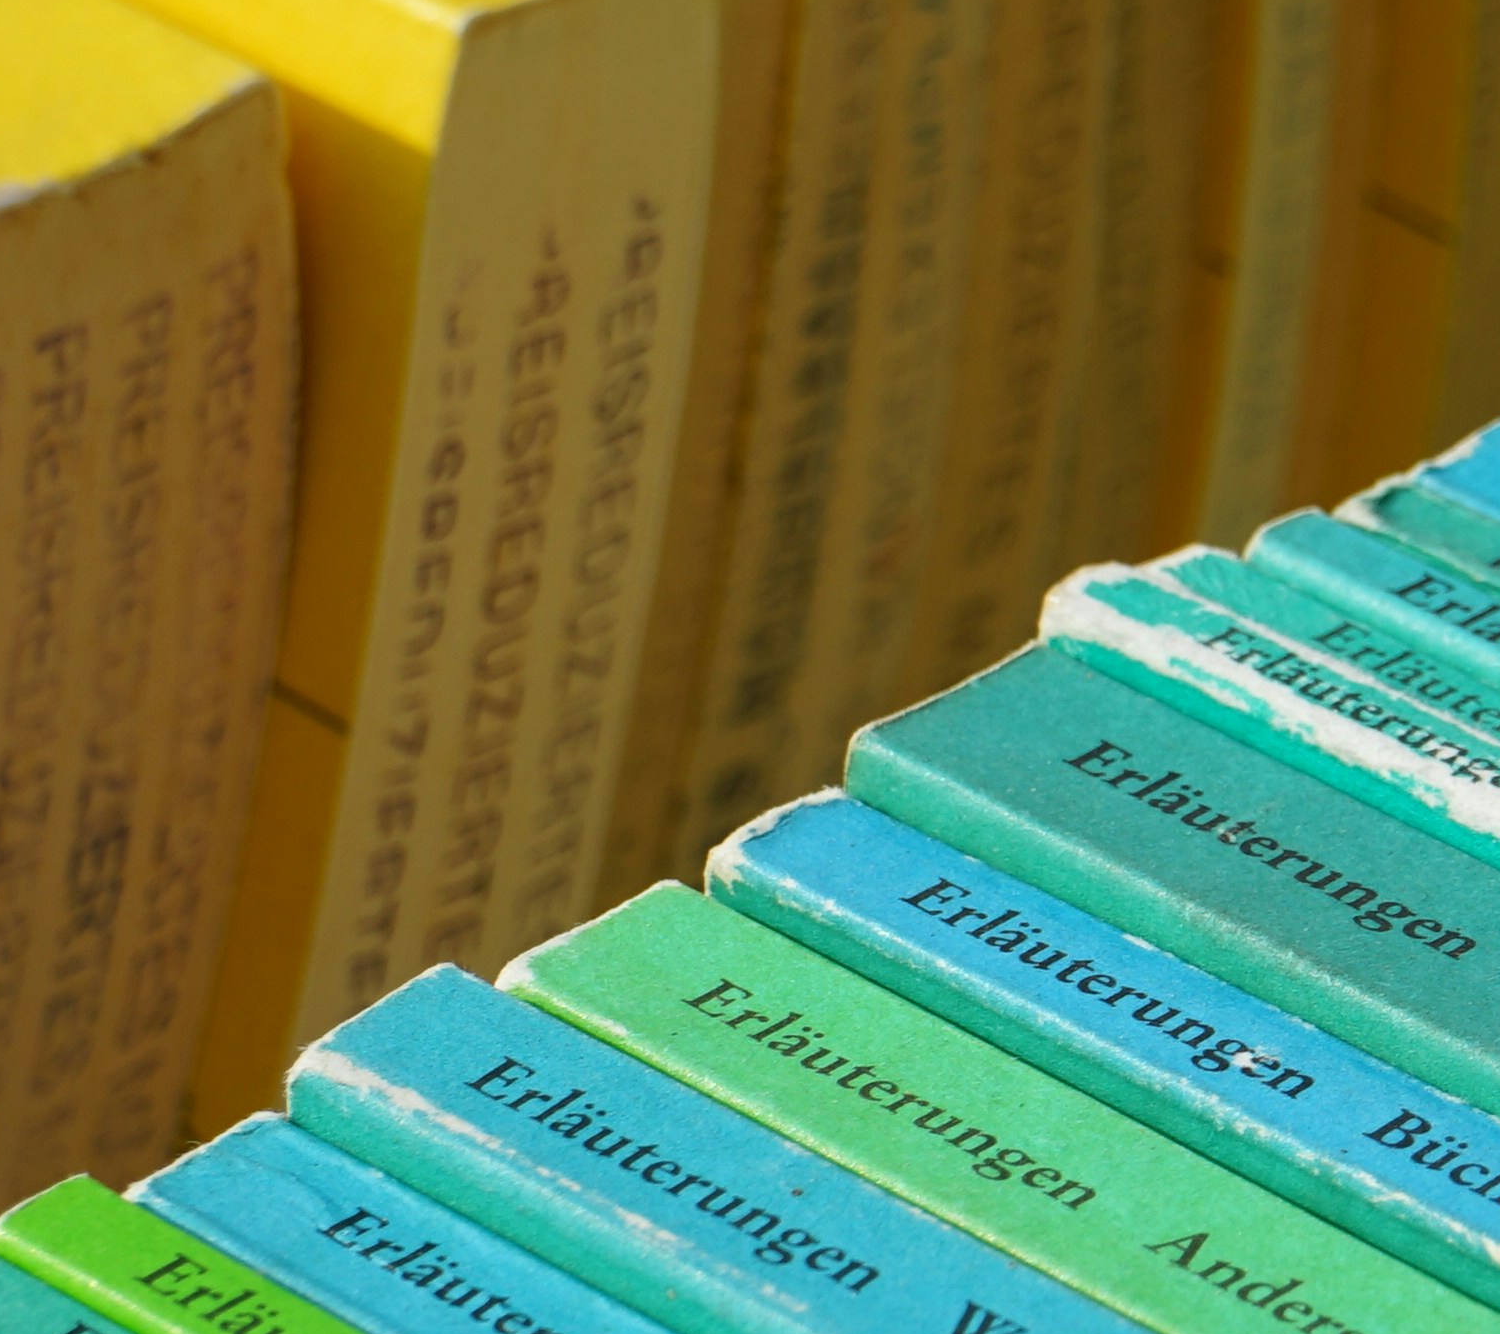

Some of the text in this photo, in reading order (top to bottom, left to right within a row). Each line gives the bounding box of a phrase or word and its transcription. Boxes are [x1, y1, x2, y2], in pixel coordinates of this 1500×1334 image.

[1062, 738, 1479, 962] Erläuterungen
[682, 977, 1100, 1214] Erläuterungen
[900, 876, 1317, 1102] Erläuterungen
[465, 1055, 883, 1297] Erläuterungen
